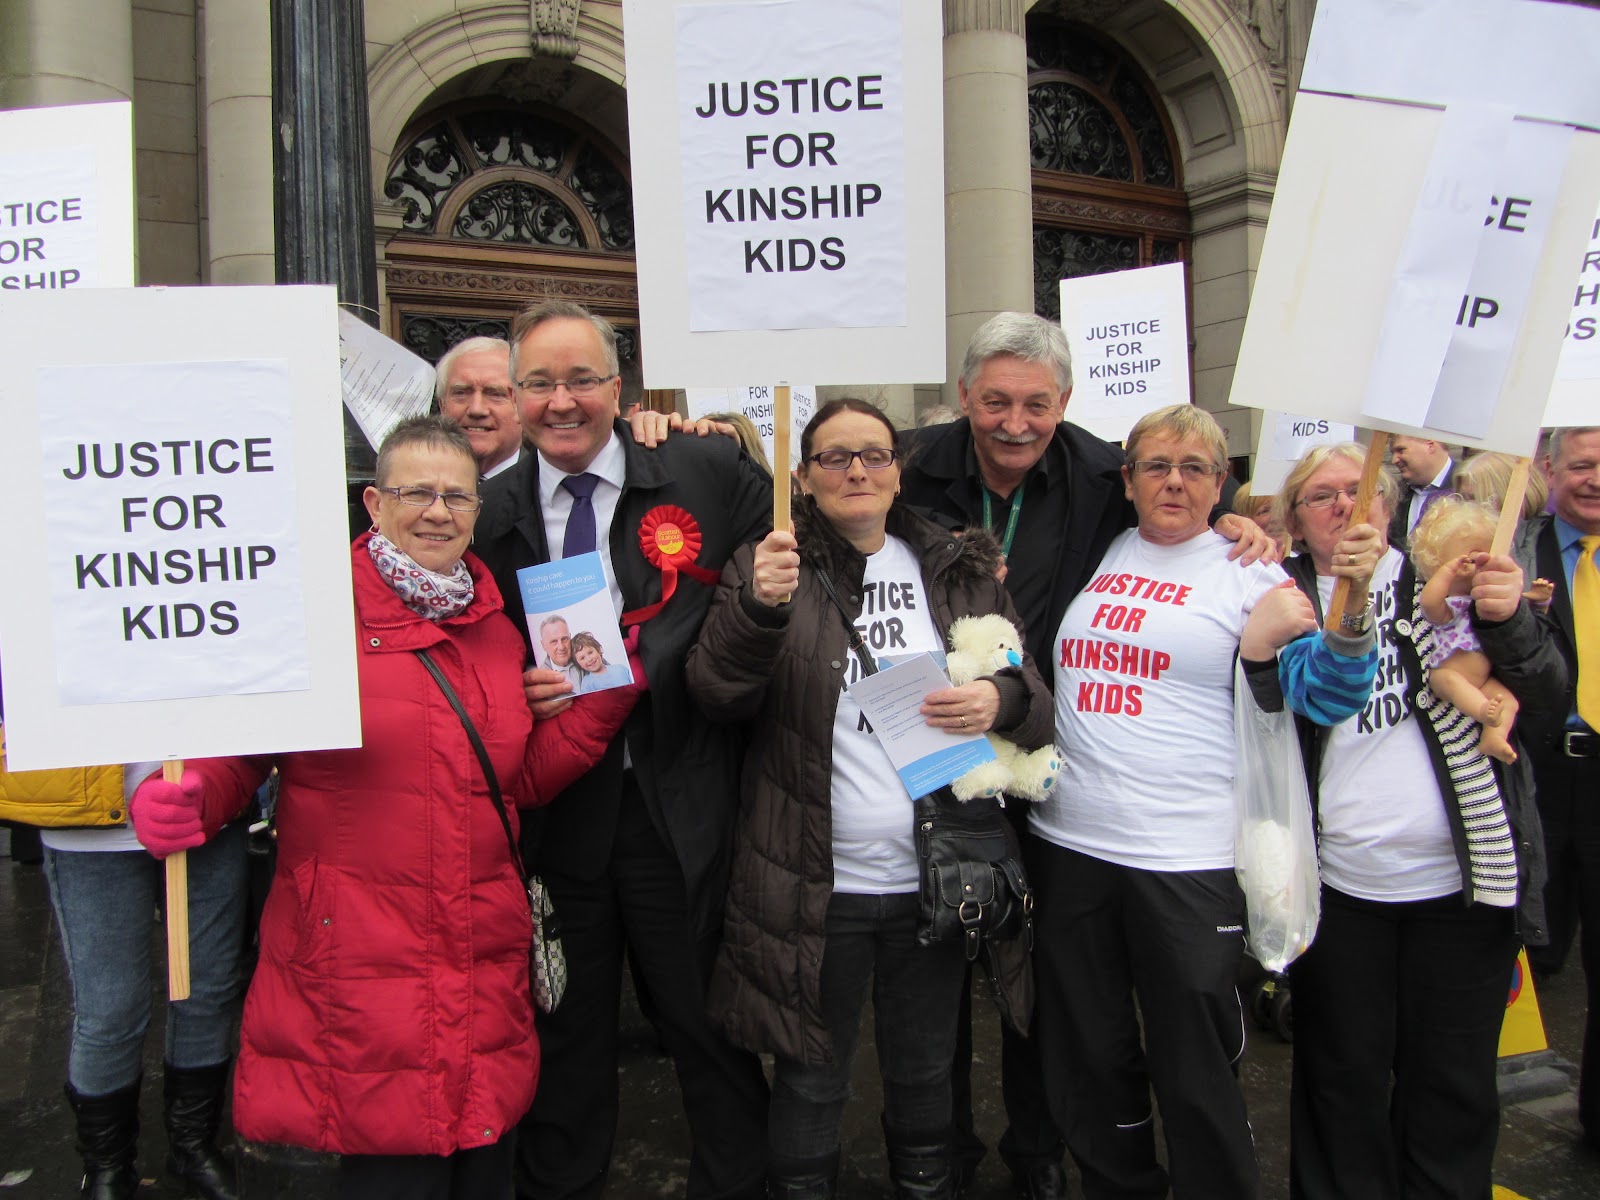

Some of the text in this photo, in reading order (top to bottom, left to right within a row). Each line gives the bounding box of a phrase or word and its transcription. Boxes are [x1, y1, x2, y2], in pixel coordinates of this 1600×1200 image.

[695, 75, 884, 119] JUSTICE
[746, 132, 838, 169] FOR
[0, 197, 82, 227] TICE
[705, 183, 882, 223] KINSHIP
[0, 237, 46, 264] OR
[744, 237, 846, 273] KIDS
[1, 268, 81, 289] SHIP
[1086, 319, 1161, 341] JUSTICE
[1105, 341, 1143, 358] FOR
[1089, 358, 1161, 379] KINSHIP
[749, 386, 769, 399] FOR
[1105, 379, 1147, 397] KIDS
[742, 404, 774, 419] KINSHI
[1291, 420, 1330, 437] KIDS
[62, 437, 275, 481] JUSTICE
[121, 493, 228, 533] FOR
[75, 545, 277, 590] KINSHIP
[863, 581, 916, 615] TICE
[1084, 573, 1193, 606] JUSTICE
[122, 600, 240, 642] KIDS
[1090, 603, 1147, 633] FOR
[1060, 638, 1171, 681] KINSHIP
[1077, 681, 1143, 716] KIDS
